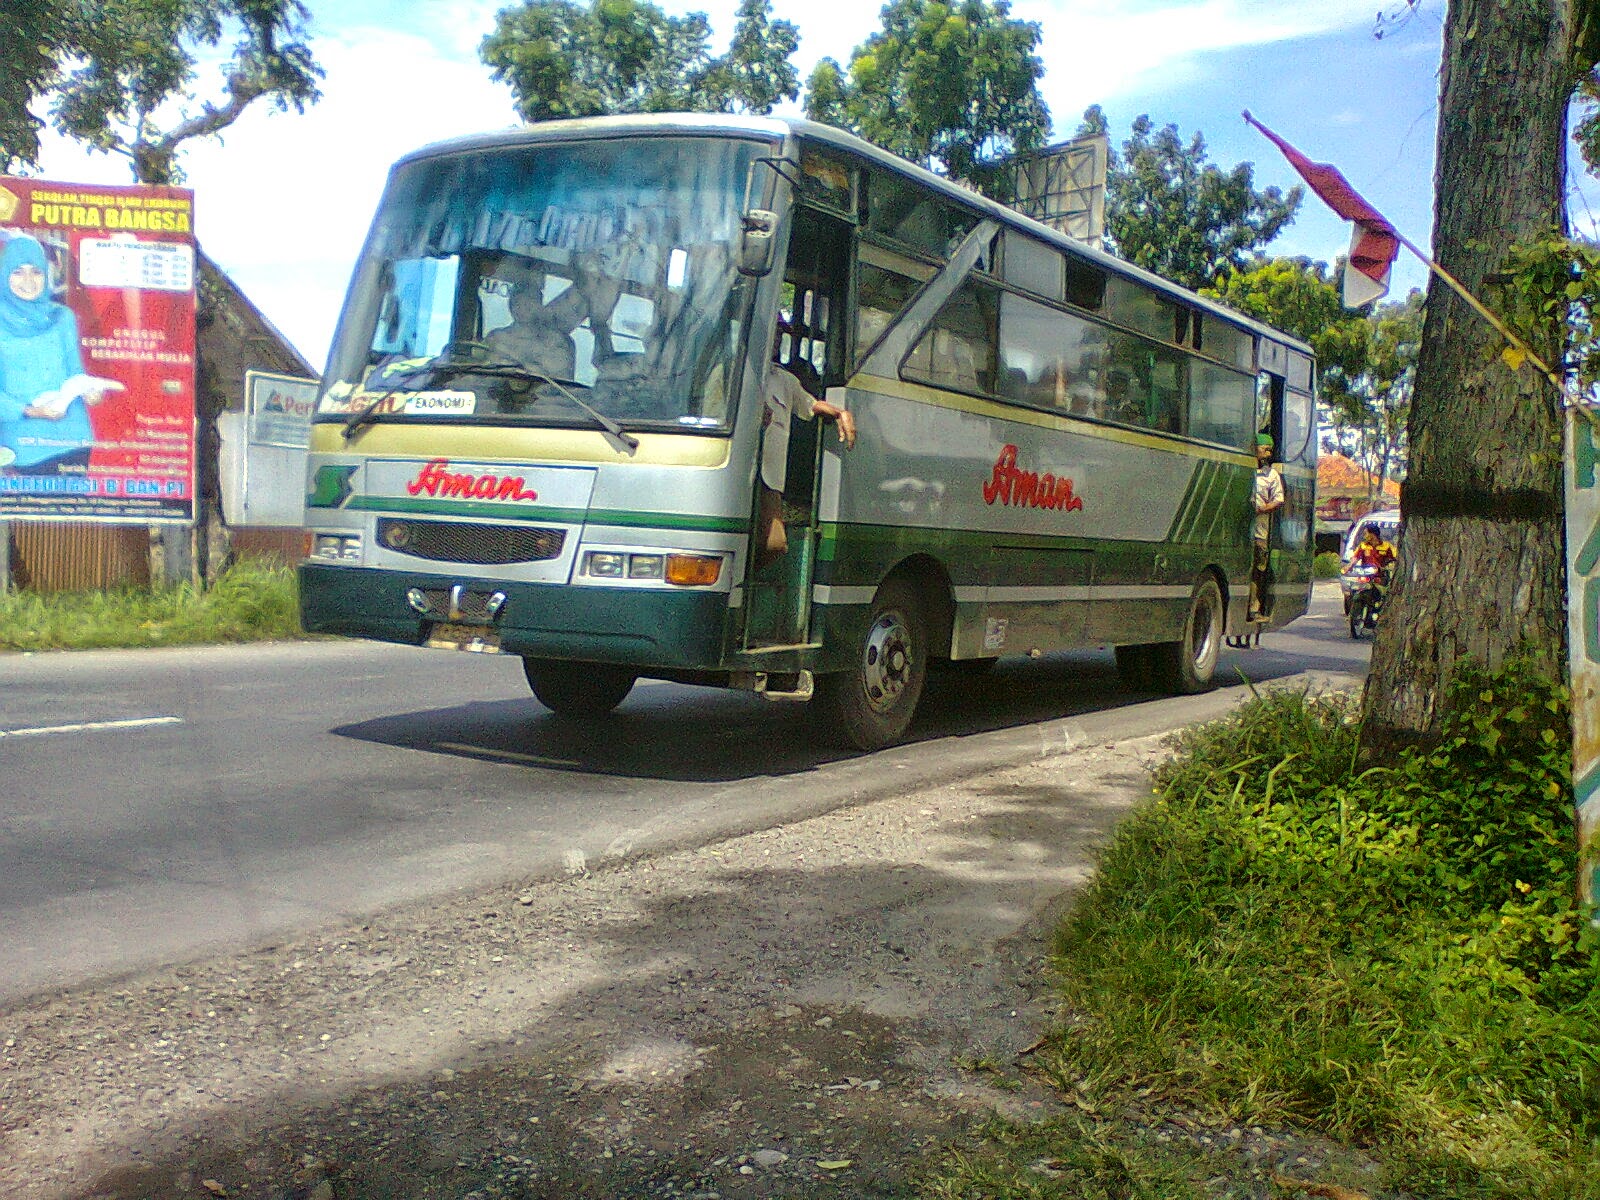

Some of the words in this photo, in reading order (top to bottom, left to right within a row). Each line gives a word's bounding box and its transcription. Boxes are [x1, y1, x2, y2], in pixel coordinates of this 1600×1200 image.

[31, 203, 100, 226] PUTRA
[105, 208, 190, 232] BANGSA
[407, 458, 537, 501] Aman
[983, 444, 1082, 512] Aman
